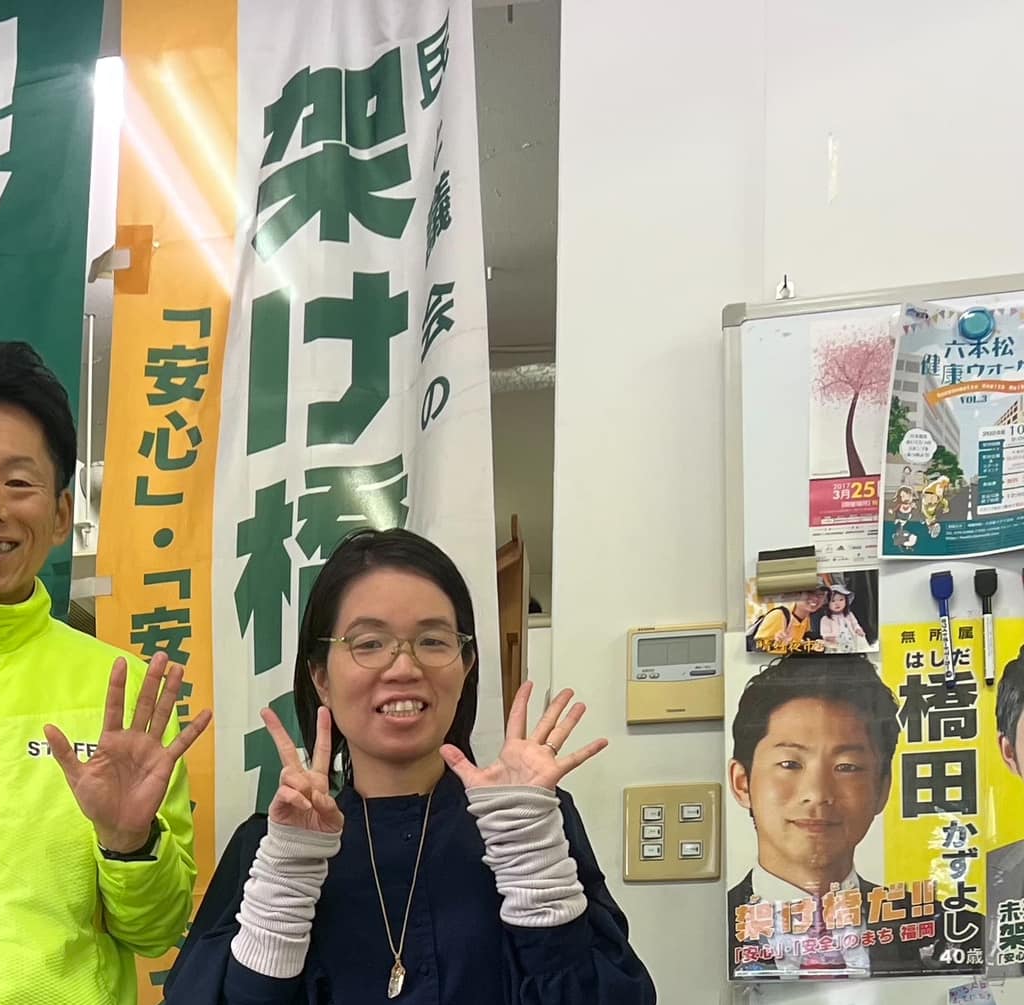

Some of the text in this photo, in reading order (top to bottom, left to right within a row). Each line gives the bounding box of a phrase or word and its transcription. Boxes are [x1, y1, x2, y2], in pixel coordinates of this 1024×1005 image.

[851, 481, 875, 499] 25
[28, 741, 98, 757] STFF
[898, 671, 978, 818] 橋田
[942, 820, 979, 943] かずよし
[998, 900, 1024, 921] 未
[900, 920, 936, 941] 福岡
[939, 947, 984, 966] 40歳
